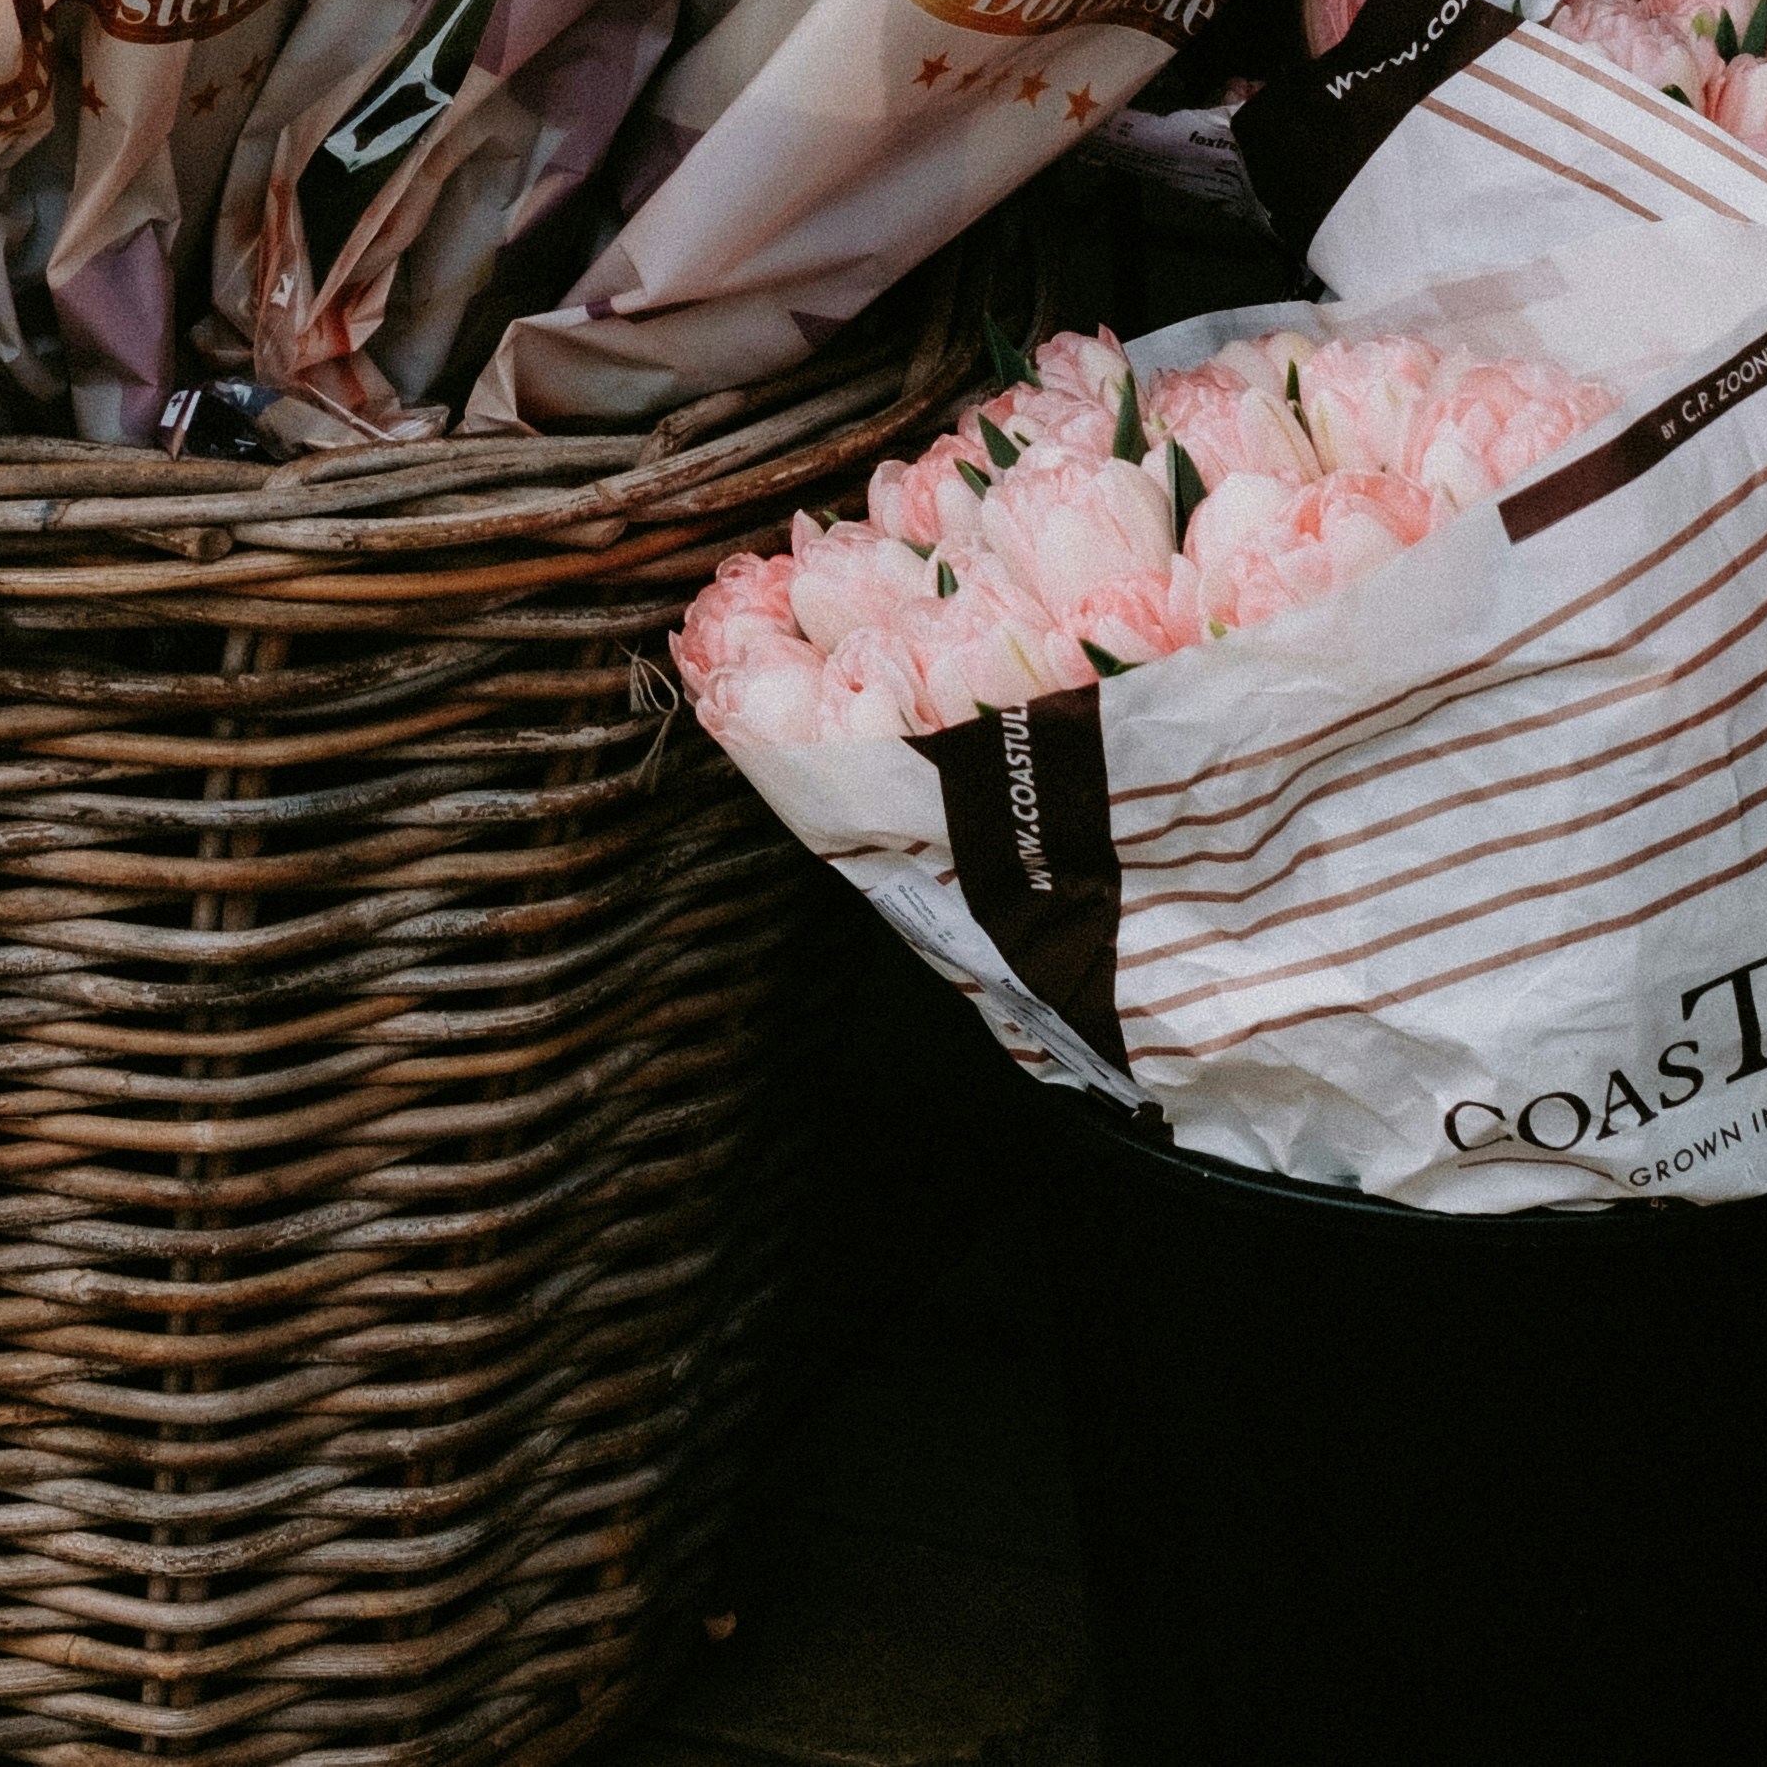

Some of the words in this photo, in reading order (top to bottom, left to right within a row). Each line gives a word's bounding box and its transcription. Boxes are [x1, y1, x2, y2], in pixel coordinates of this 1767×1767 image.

[1660, 419, 1677, 440] BY
[1682, 391, 1714, 422] C.P.
[1628, 1121, 1743, 1187] GROWN
